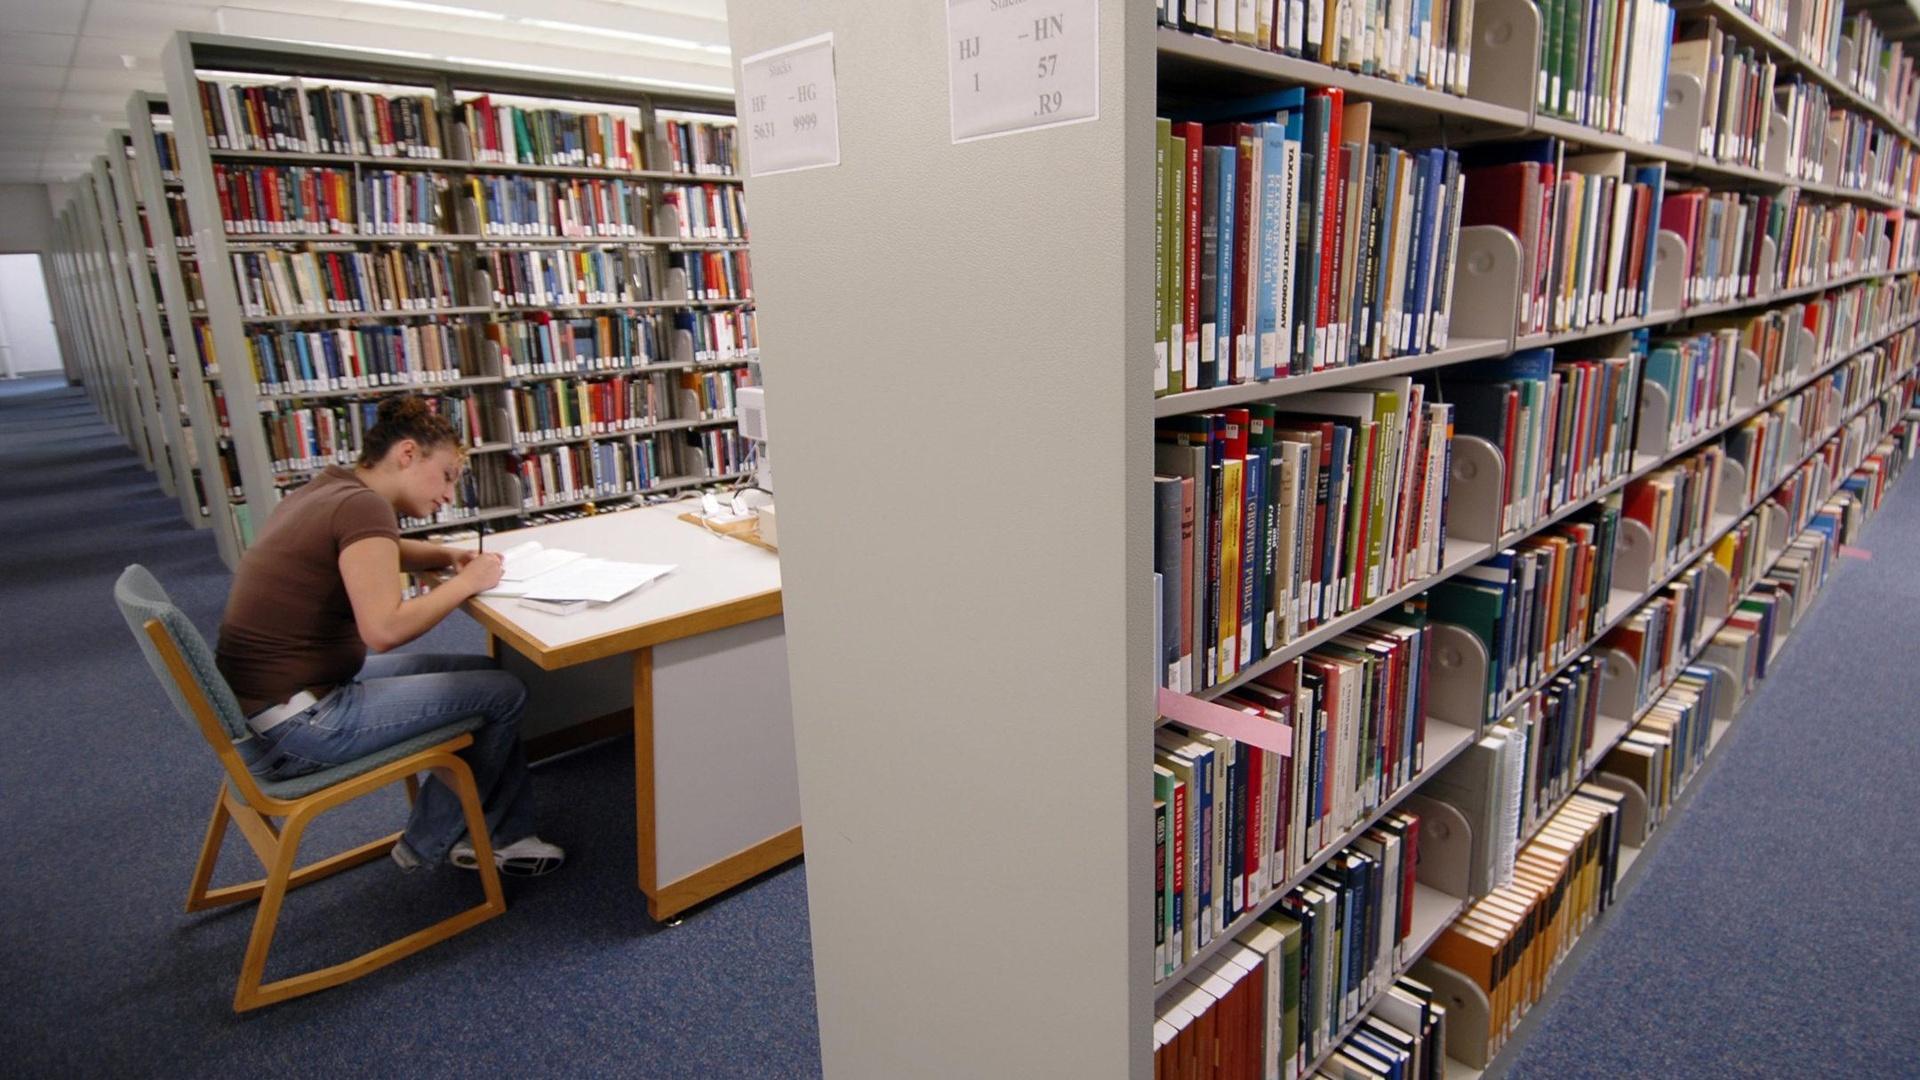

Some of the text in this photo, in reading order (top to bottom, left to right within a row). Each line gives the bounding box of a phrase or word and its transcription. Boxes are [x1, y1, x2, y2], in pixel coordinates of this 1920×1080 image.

[959, 36, 980, 60] HJ
[1038, 54, 1058, 78] 57
[752, 95, 767, 113] HF
[753, 111, 817, 140] 5631 9999
[1286, 147, 1294, 210] TAXATION
[1264, 174, 1274, 285] PUBLIC SECTOR
[1283, 222, 1292, 267] DEFICIT
[1280, 269, 1289, 329] ECONOMY
[1244, 502, 1257, 613] GROWING PUBLIC
[1176, 793, 1184, 837] RUNNING
[1176, 840, 1182, 854] ON
